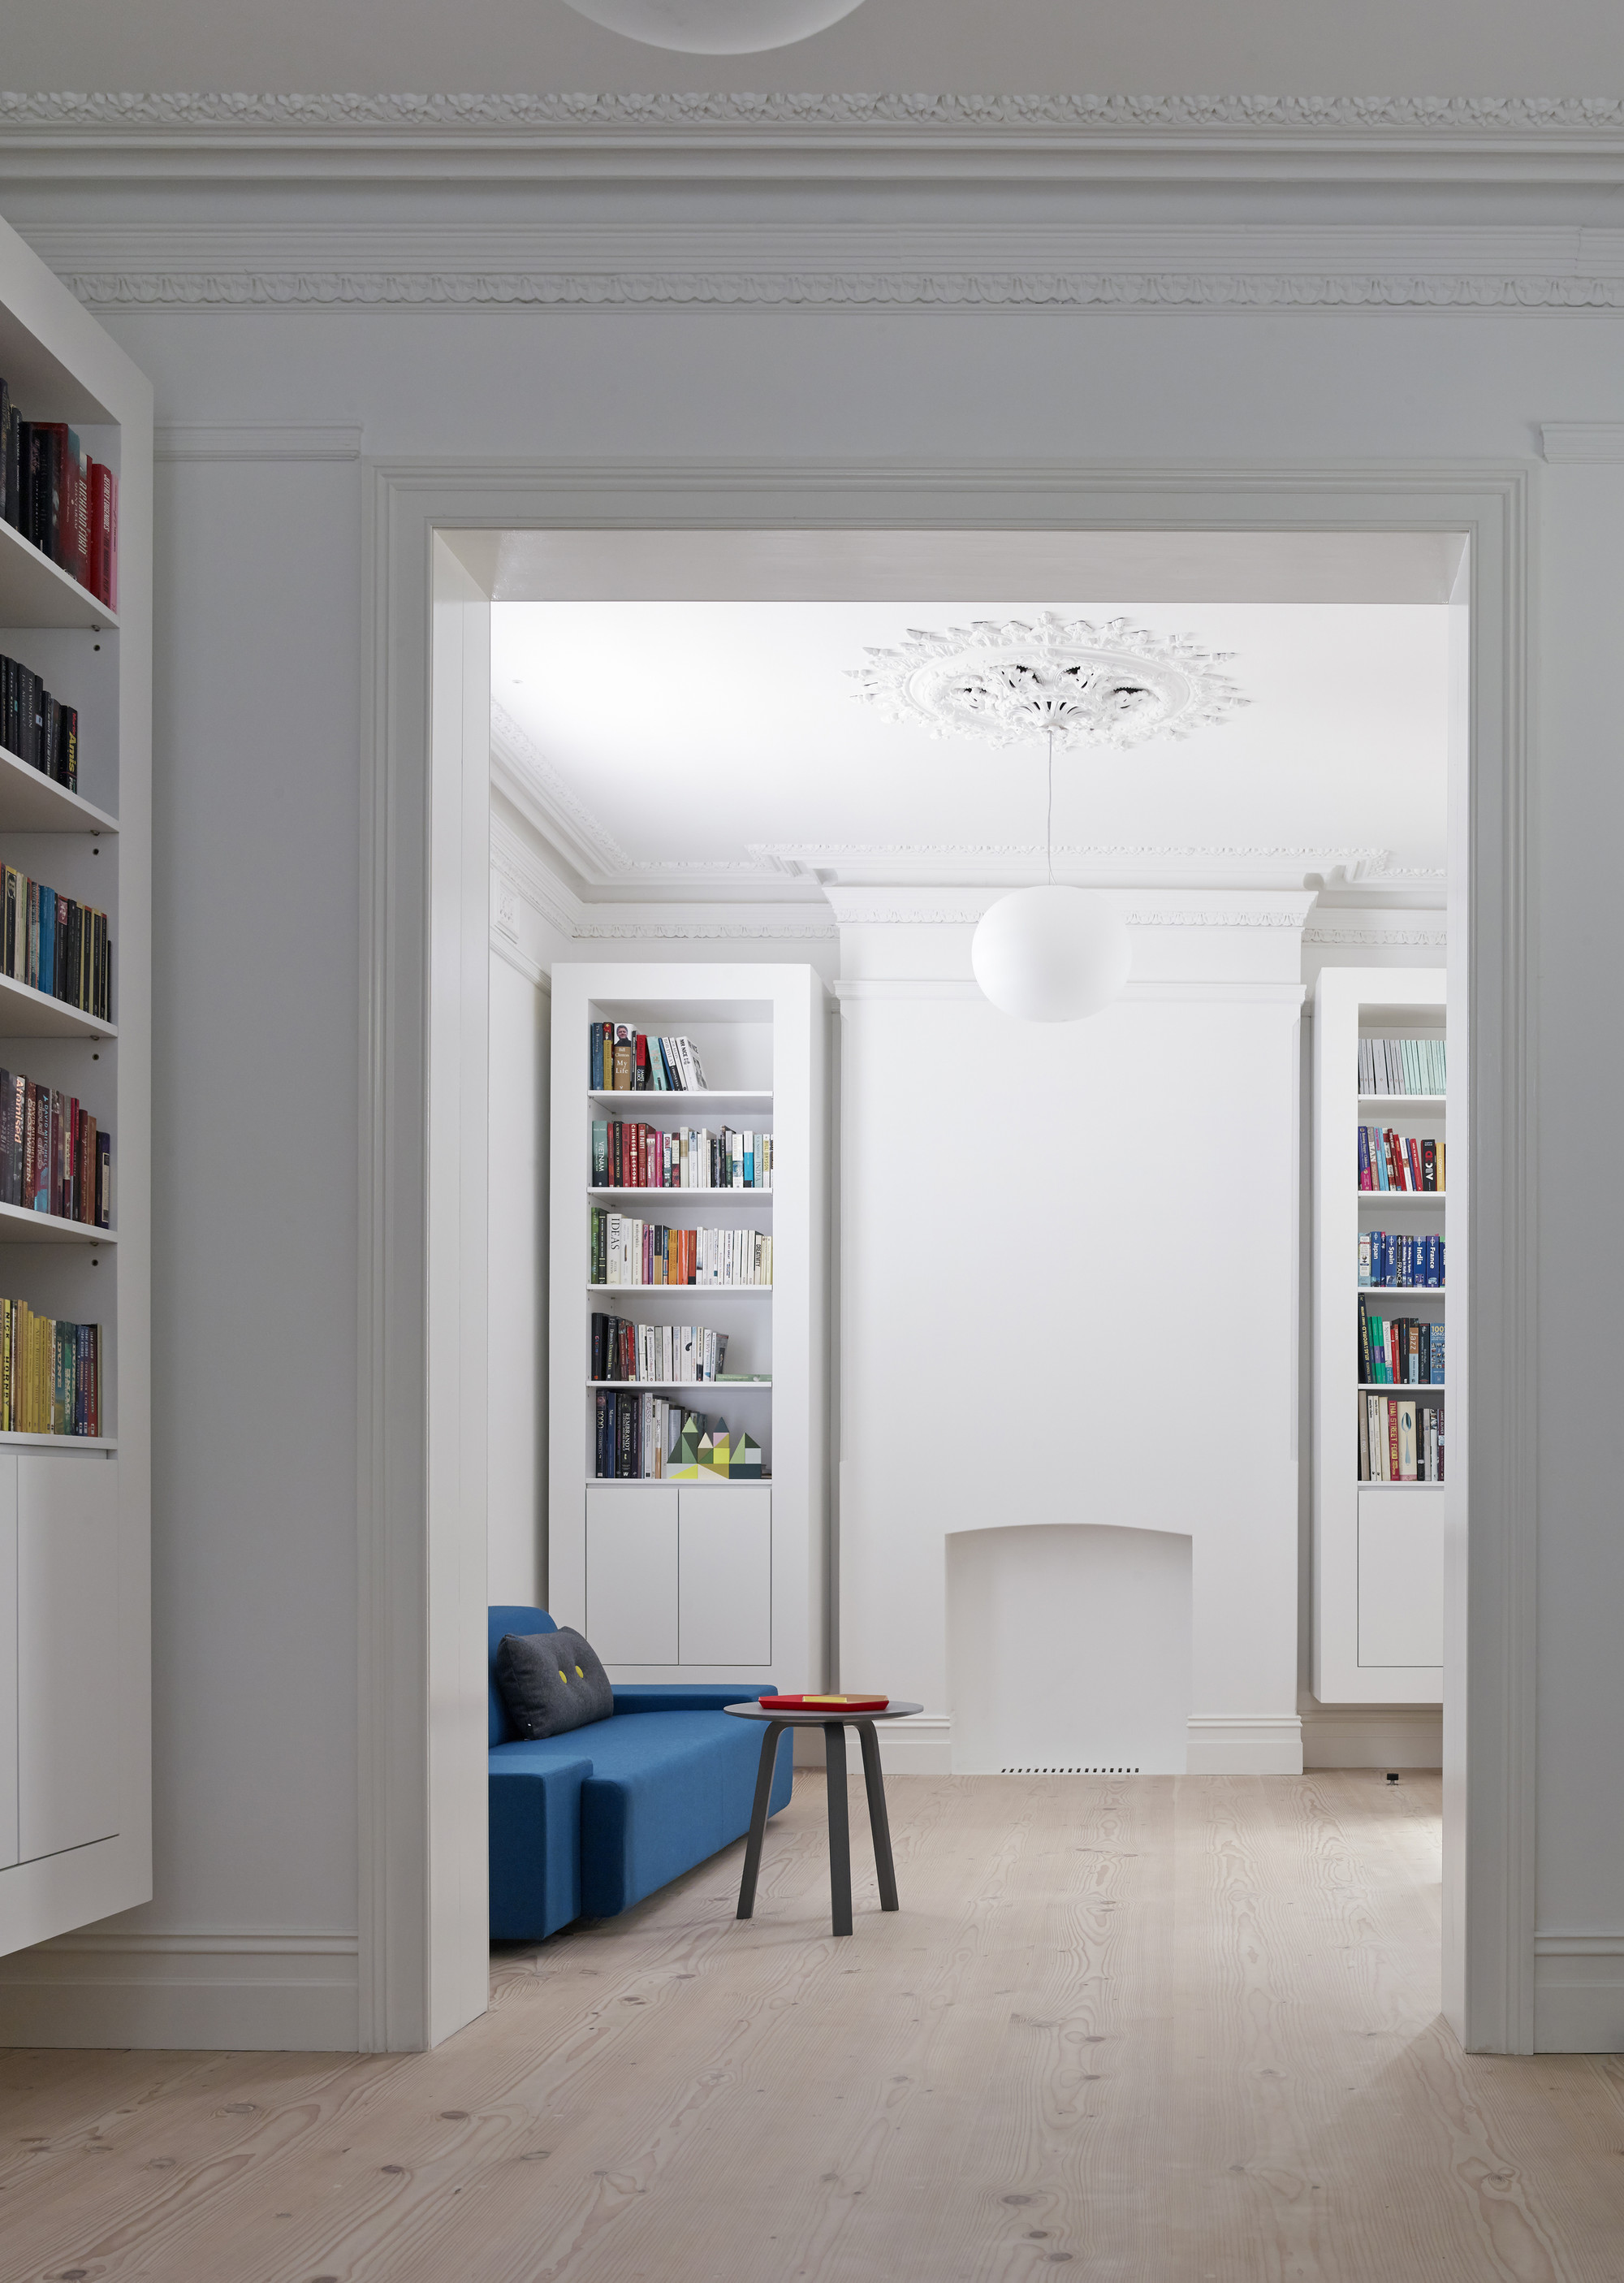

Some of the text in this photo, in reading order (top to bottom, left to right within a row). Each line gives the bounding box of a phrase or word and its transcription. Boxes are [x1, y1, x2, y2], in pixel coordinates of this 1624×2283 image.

[78, 479, 87, 555] RICHARD FORD
[617, 1060, 628, 1069] My
[14, 1078, 24, 1144] Atomised
[611, 1217, 620, 1250] IDEAS
[1410, 1331, 1418, 1350] Jazz
